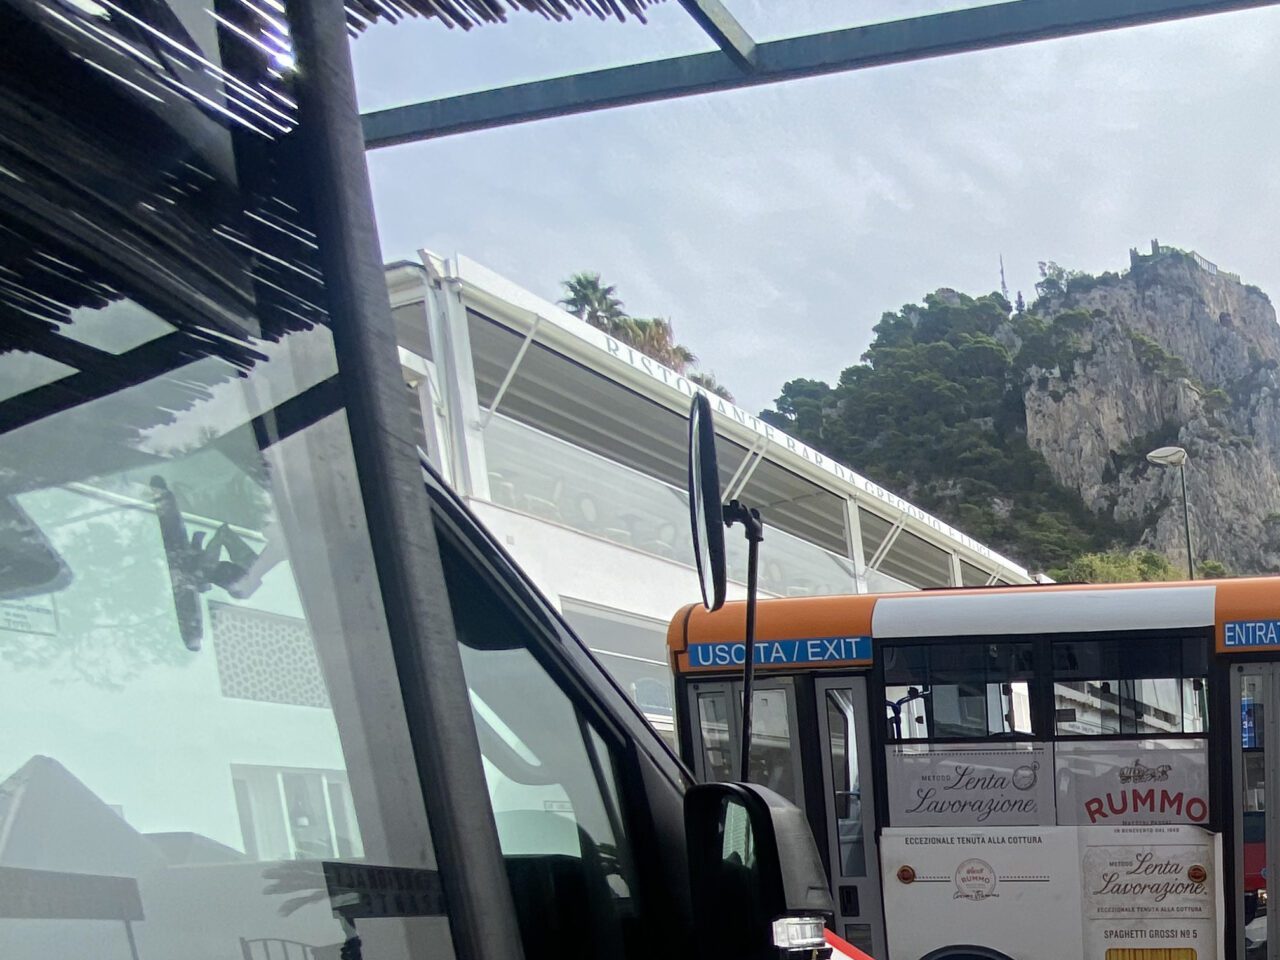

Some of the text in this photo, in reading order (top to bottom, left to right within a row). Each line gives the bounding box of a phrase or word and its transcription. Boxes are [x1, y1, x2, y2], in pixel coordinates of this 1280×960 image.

[698, 641, 786, 666] USCTA
[807, 638, 861, 661] EXIT
[944, 765, 1009, 790] Lenta
[1084, 788, 1208, 823] RUMMO
[905, 835, 1043, 845] ECCEZIONALE TENUTA ALLA COTTURA
[1126, 852, 1184, 875] Lenta
[1104, 930, 1147, 939] SPAGHETTI
[1149, 930, 1178, 939] GROSSI
[1192, 929, 1198, 938] 5
